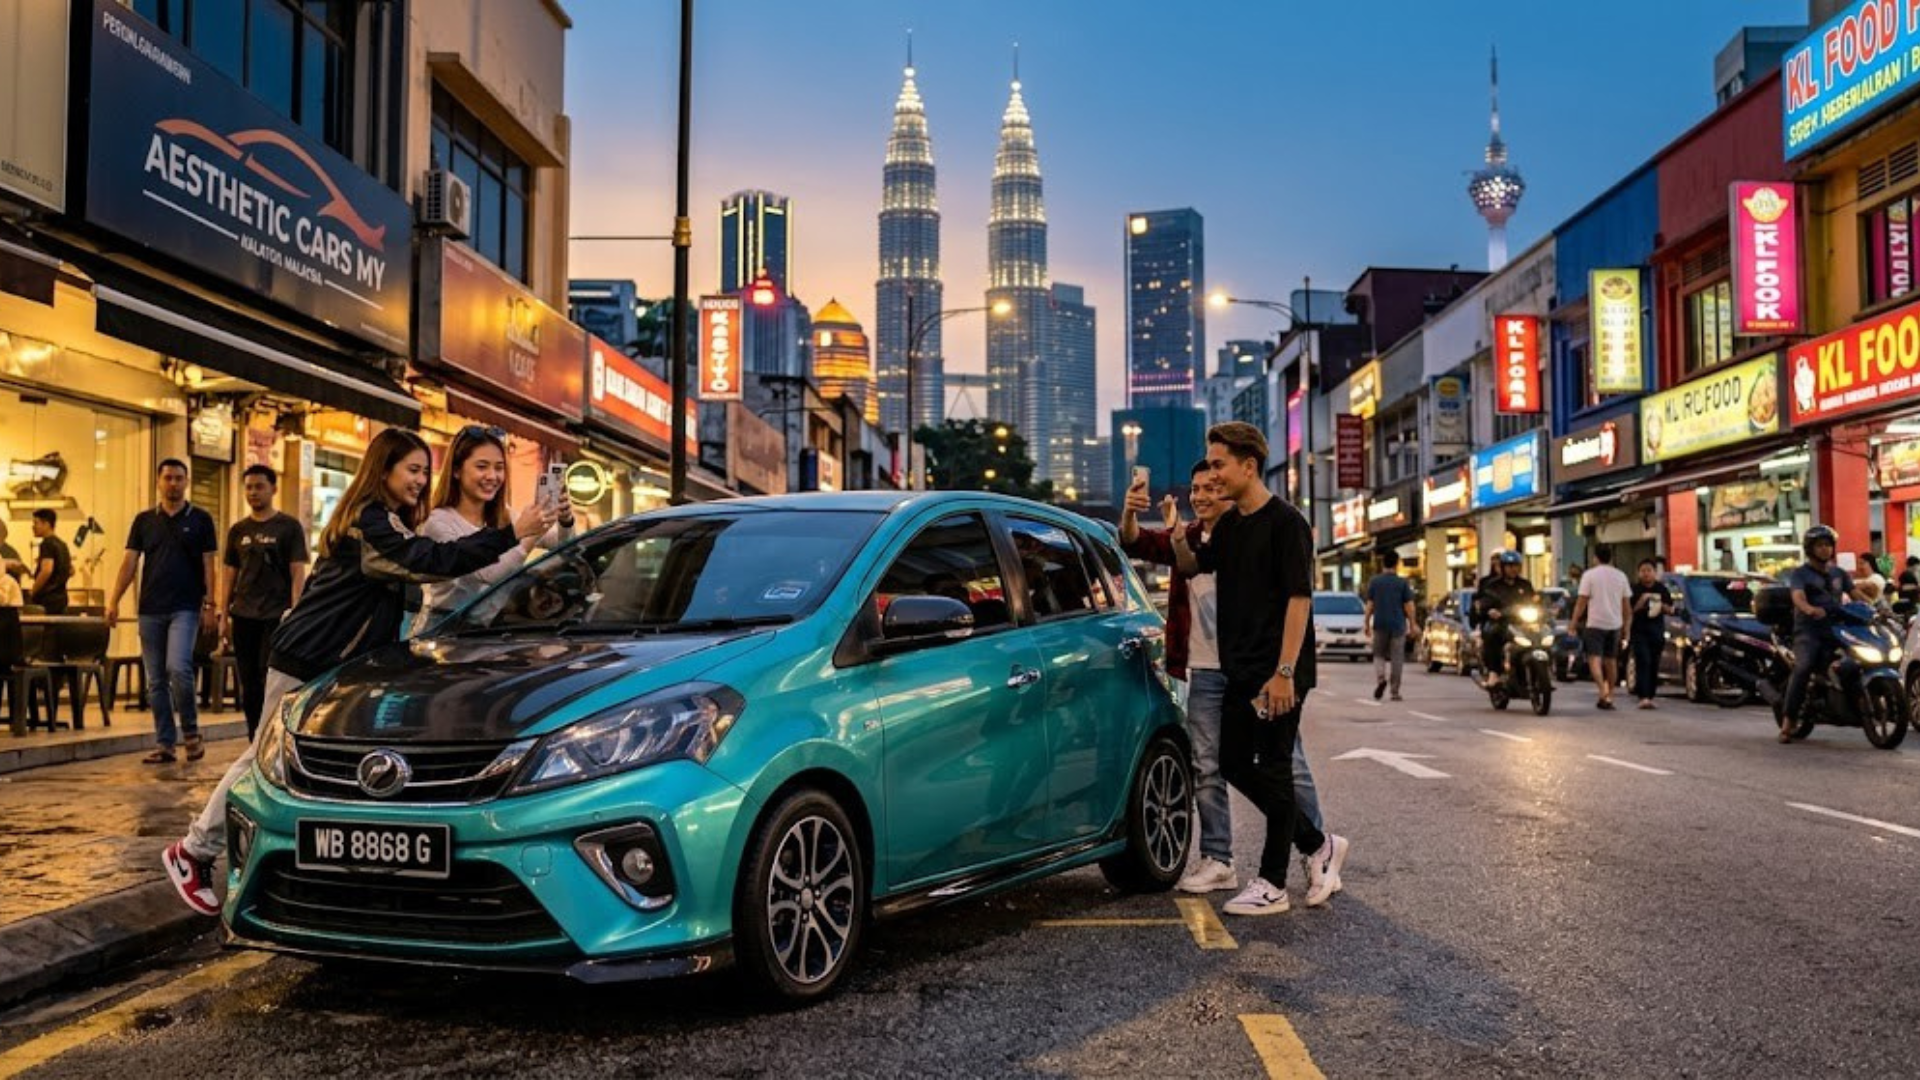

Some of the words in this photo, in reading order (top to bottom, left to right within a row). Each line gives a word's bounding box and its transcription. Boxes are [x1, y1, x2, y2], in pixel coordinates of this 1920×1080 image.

[1786, 46, 1820, 115] KL
[1824, 0, 1899, 91] FOOD
[144, 133, 292, 244] AESTHETIC
[296, 217, 353, 275] CARS
[356, 249, 387, 292] MY
[1818, 339, 1854, 394] KL
[1859, 314, 1920, 382] FOO
[315, 827, 345, 859] WB
[350, 830, 410, 862] 8868
[416, 833, 431, 863] G
